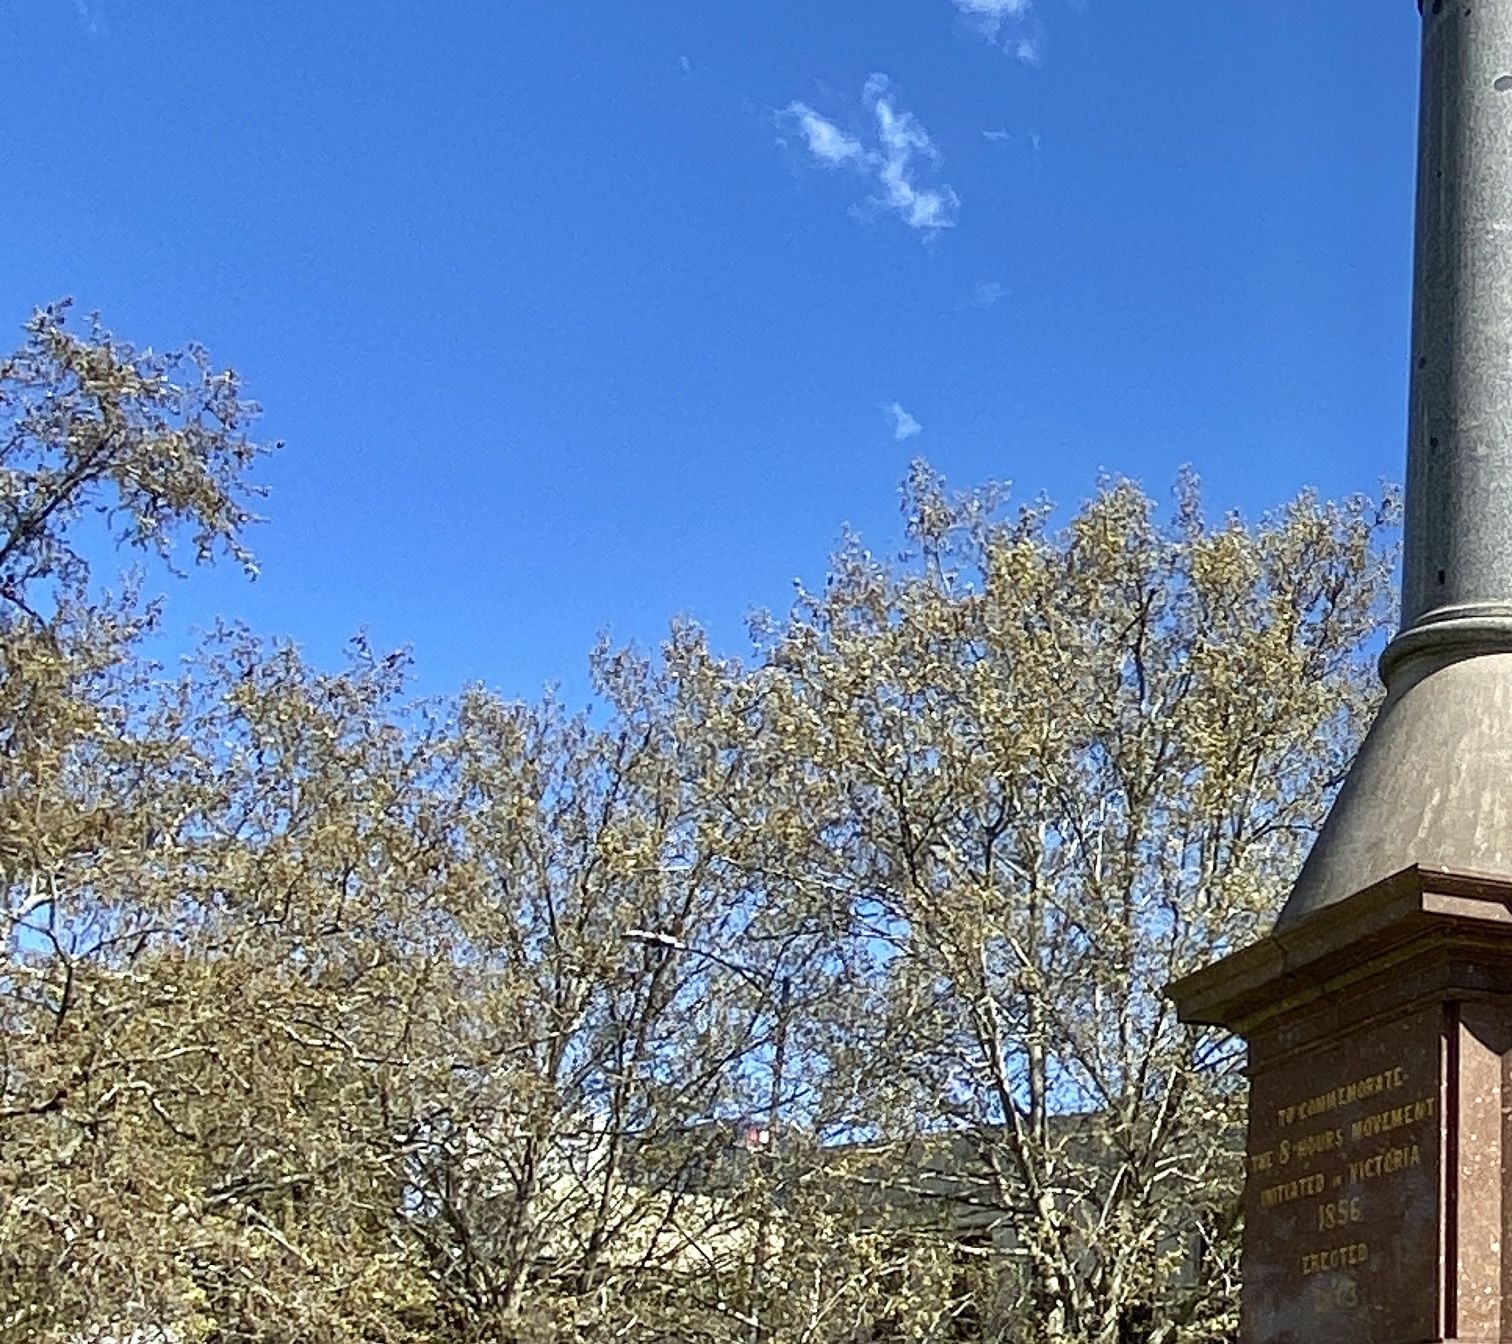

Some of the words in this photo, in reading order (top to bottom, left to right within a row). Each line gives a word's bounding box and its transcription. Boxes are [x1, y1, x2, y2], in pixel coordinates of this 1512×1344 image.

[1277, 1106, 1295, 1128] TO
[1298, 1065, 1403, 1120] COMMEMORATE
[1250, 1150, 1274, 1172] THE
[1279, 1139, 1291, 1164] 8
[1296, 1128, 1345, 1158] HOURS
[1351, 1097, 1436, 1141] MOVEMENT
[1259, 1173, 1326, 1207] INITIATED
[1350, 1144, 1421, 1183] VICTORIA
[1318, 1196, 1362, 1233] 1856
[1302, 1243, 1370, 1275] ERECTED
